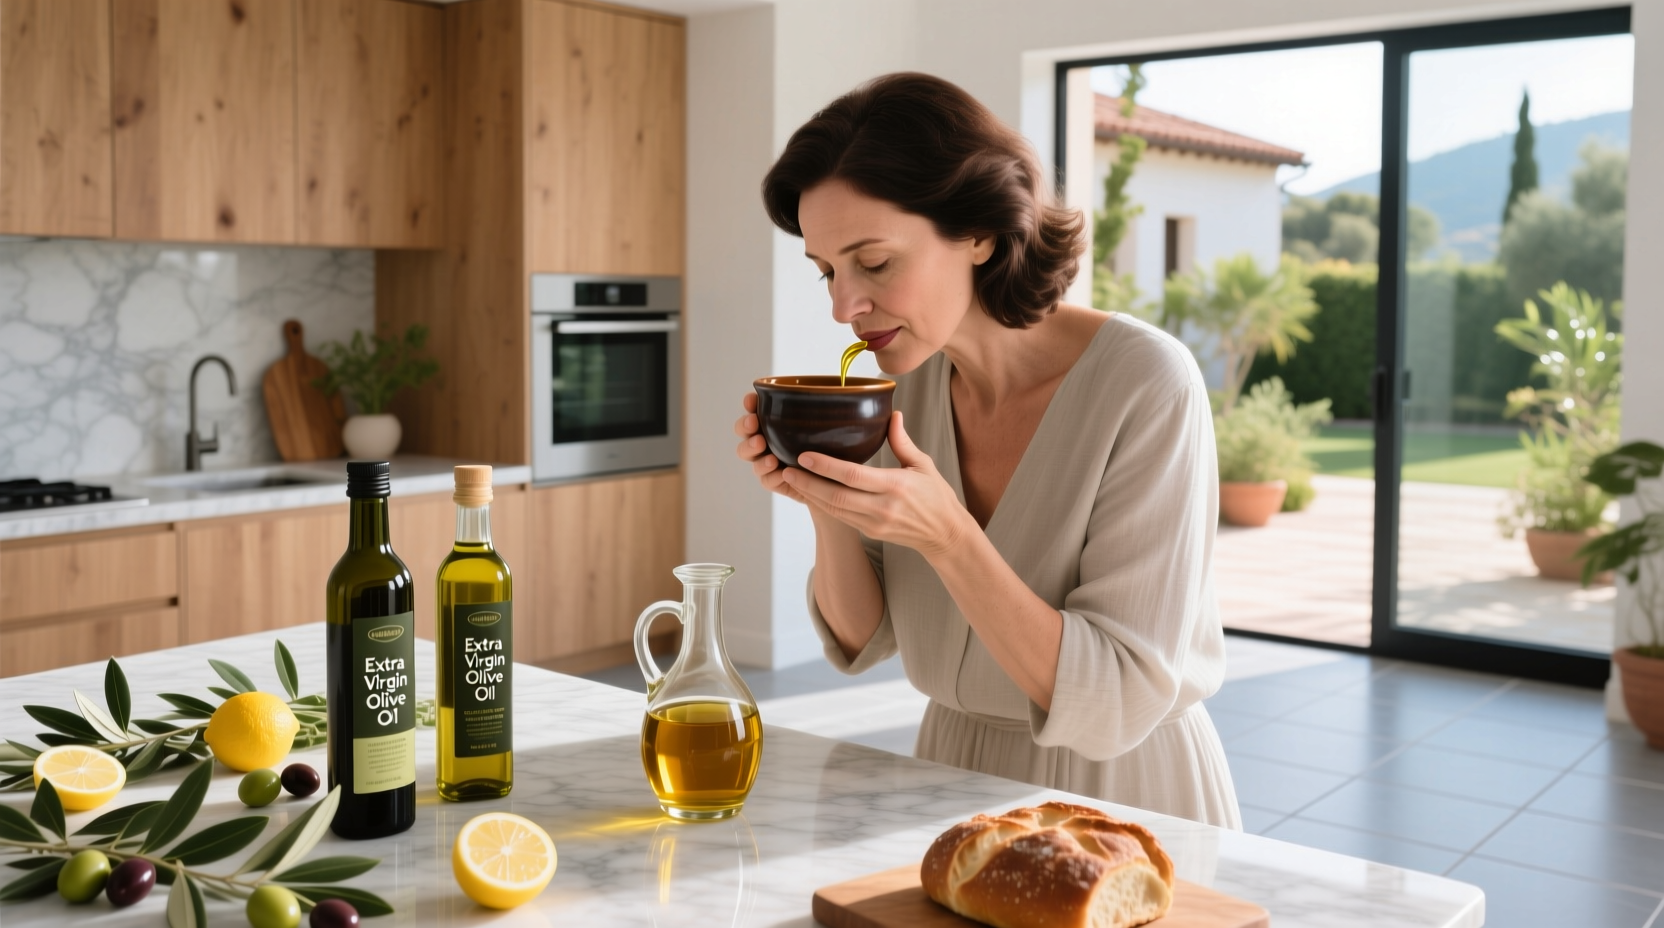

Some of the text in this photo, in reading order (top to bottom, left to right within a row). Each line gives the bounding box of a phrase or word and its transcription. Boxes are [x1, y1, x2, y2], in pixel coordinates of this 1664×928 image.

[465, 637, 502, 652] Extra
[365, 656, 405, 673] Extra
[366, 691, 406, 710] Olive
